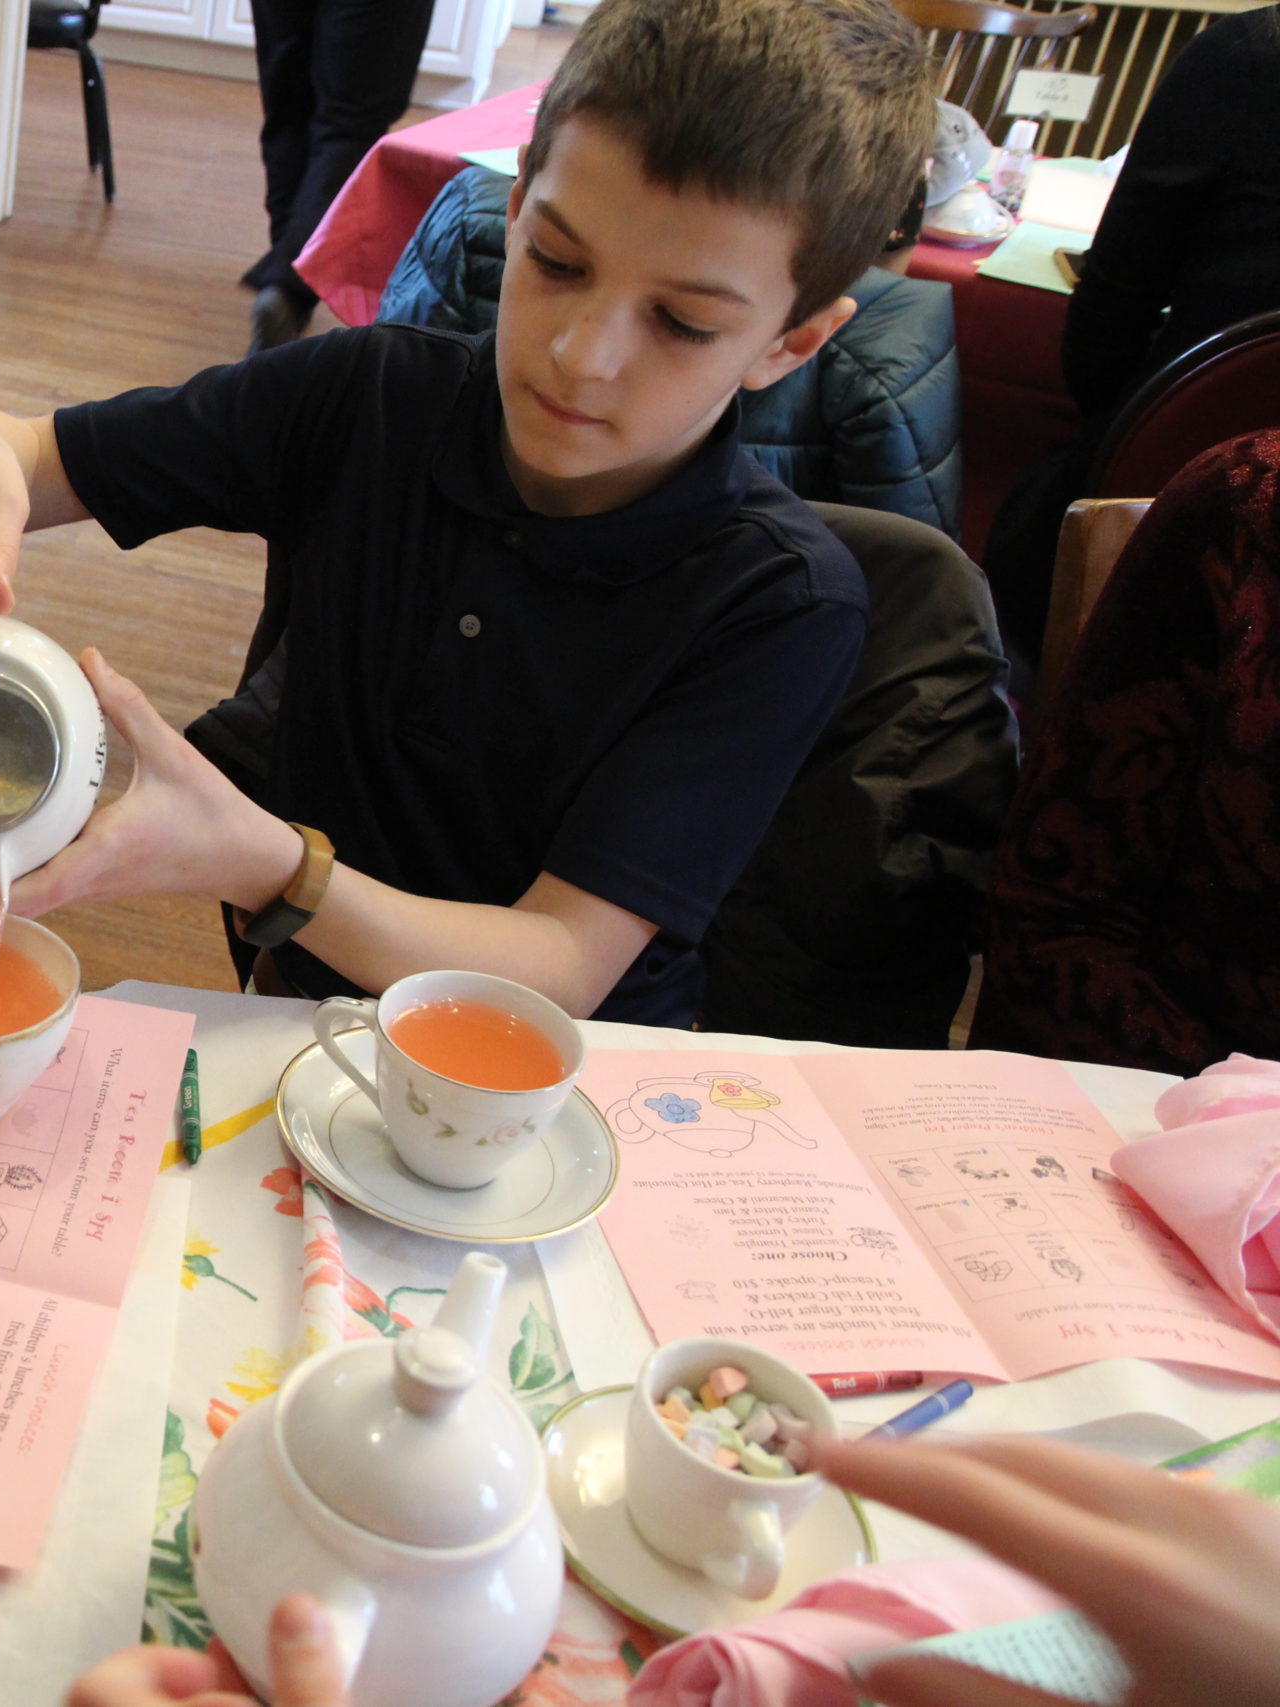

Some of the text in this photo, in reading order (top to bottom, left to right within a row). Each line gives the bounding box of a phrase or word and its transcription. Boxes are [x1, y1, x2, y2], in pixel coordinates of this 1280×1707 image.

[182, 1085, 192, 1109] Green
[51, 1047, 123, 1257] What items can you see from your table?
[107, 1134, 136, 1184] Room
[714, 1178, 725, 1186] or
[692, 1196, 734, 1206] Cheese
[736, 1196, 747, 1204] &
[750, 1195, 804, 1204] Macaroni
[739, 1207, 749, 1215] &
[753, 1206, 788, 1215] Butter
[790, 1205, 829, 1215] Peanut
[728, 1217, 769, 1225] Cheese
[772, 1217, 782, 1225] &
[736, 1227, 832, 1236] Cheese Turnover
[732, 1237, 850, 1248] Cucumber Triangles
[750, 1250, 848, 1261] Choose one:
[732, 1277, 757, 1288] $10
[744, 1289, 902, 1304] Gold Fish Crackers &
[797, 1302, 842, 1317] finger
[883, 1304, 920, 1317] fresh
[703, 1325, 737, 1337] with
[740, 1322, 788, 1336] served
[792, 1321, 815, 1332] are
[817, 1319, 874, 1332] lunches
[1, 1320, 25, 1348] fresh
[2, 1365, 32, 1411] lunches
[832, 1377, 856, 1389] Red
